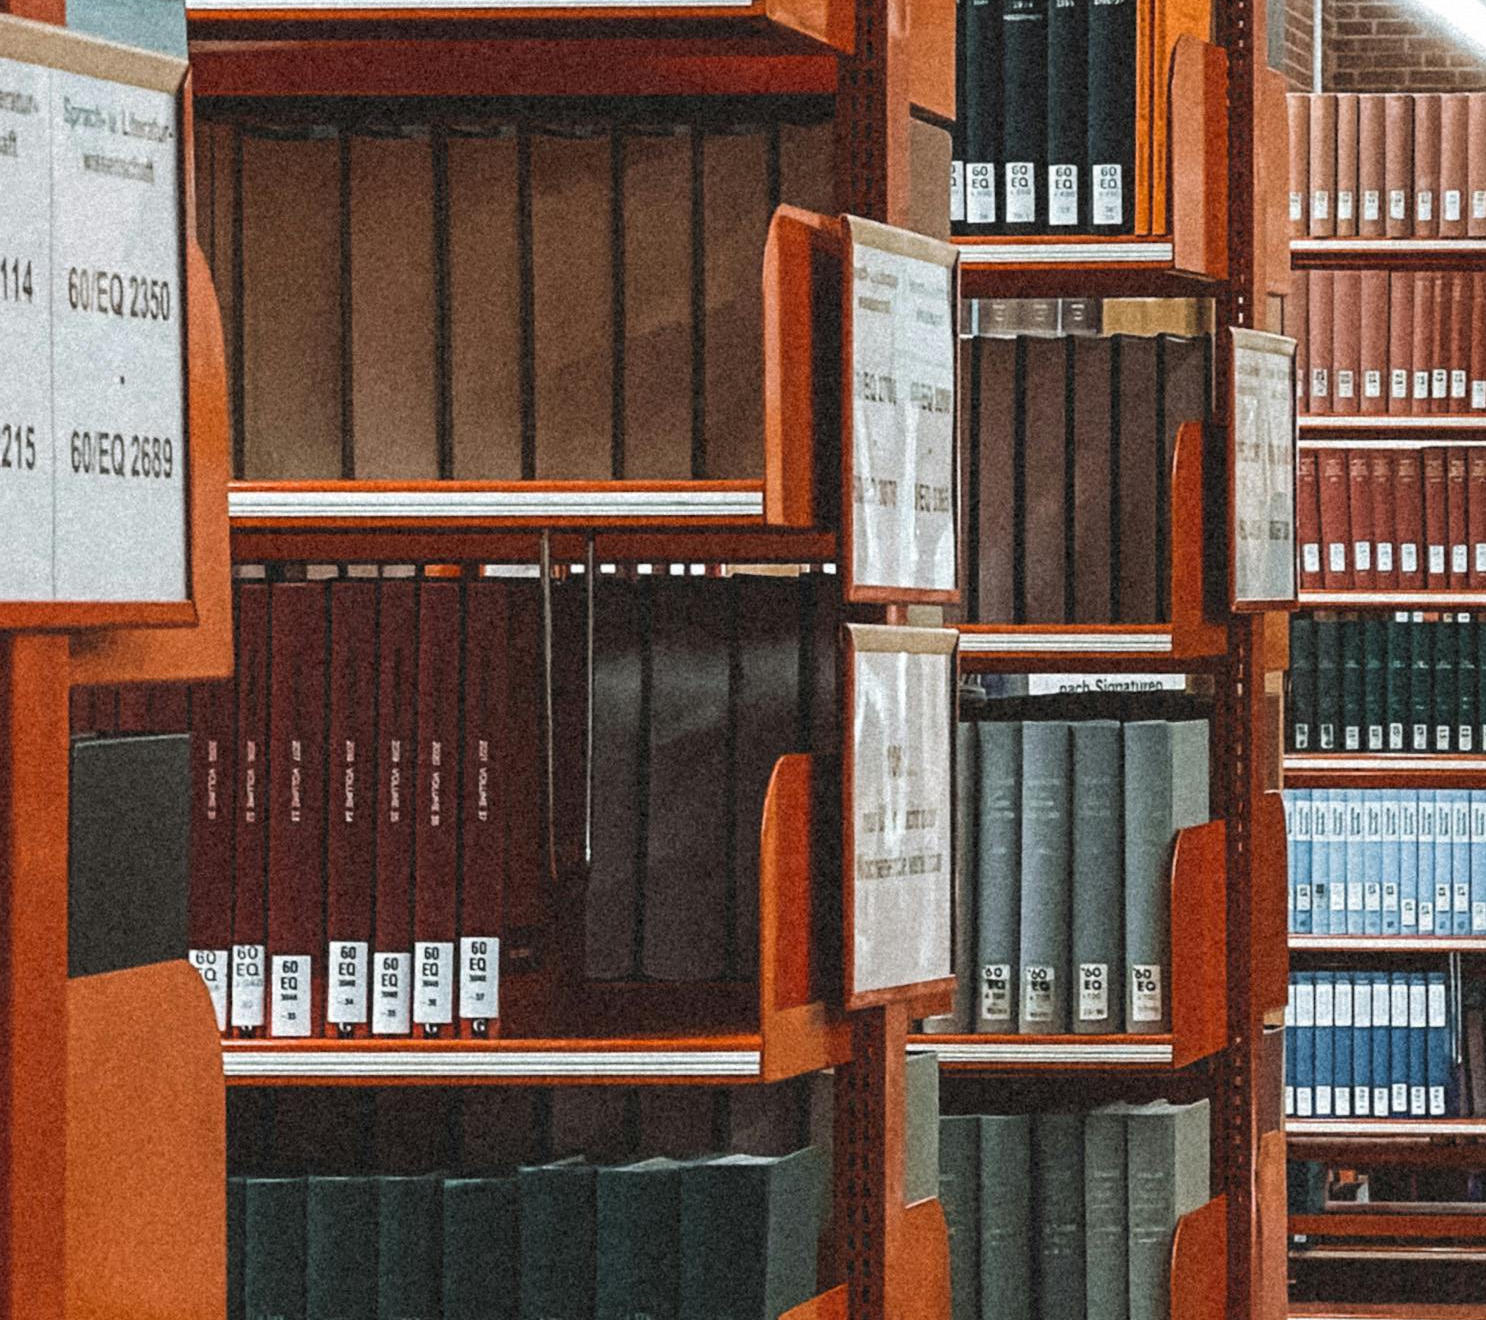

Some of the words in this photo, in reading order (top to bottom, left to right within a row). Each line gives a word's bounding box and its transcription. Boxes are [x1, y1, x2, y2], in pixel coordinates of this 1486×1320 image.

[972, 166, 988, 176] 60
[1012, 165, 1028, 175] 60
[1056, 167, 1072, 177] 60
[1101, 167, 1117, 177] 60
[971, 179, 989, 189] EQ
[1011, 177, 1028, 188] EQ
[1055, 180, 1073, 189] EQ
[1100, 179, 1117, 189] EQ
[69, 266, 124, 318] 60/EQ
[130, 275, 170, 321] 2350
[71, 430, 126, 478] 60/EQ
[131, 434, 173, 479] 2689
[340, 946, 356, 959] 60
[424, 947, 439, 960] 60
[472, 941, 487, 955] 60
[236, 963, 259, 976] EQ
[283, 960, 298, 973] 60
[338, 962, 356, 976] EQ
[383, 957, 398, 970] 60
[422, 963, 439, 976] EQ
[470, 958, 486, 971] EQ
[1085, 967, 1102, 977] 60
[281, 977, 297, 990] EQ
[382, 974, 398, 987] EQ
